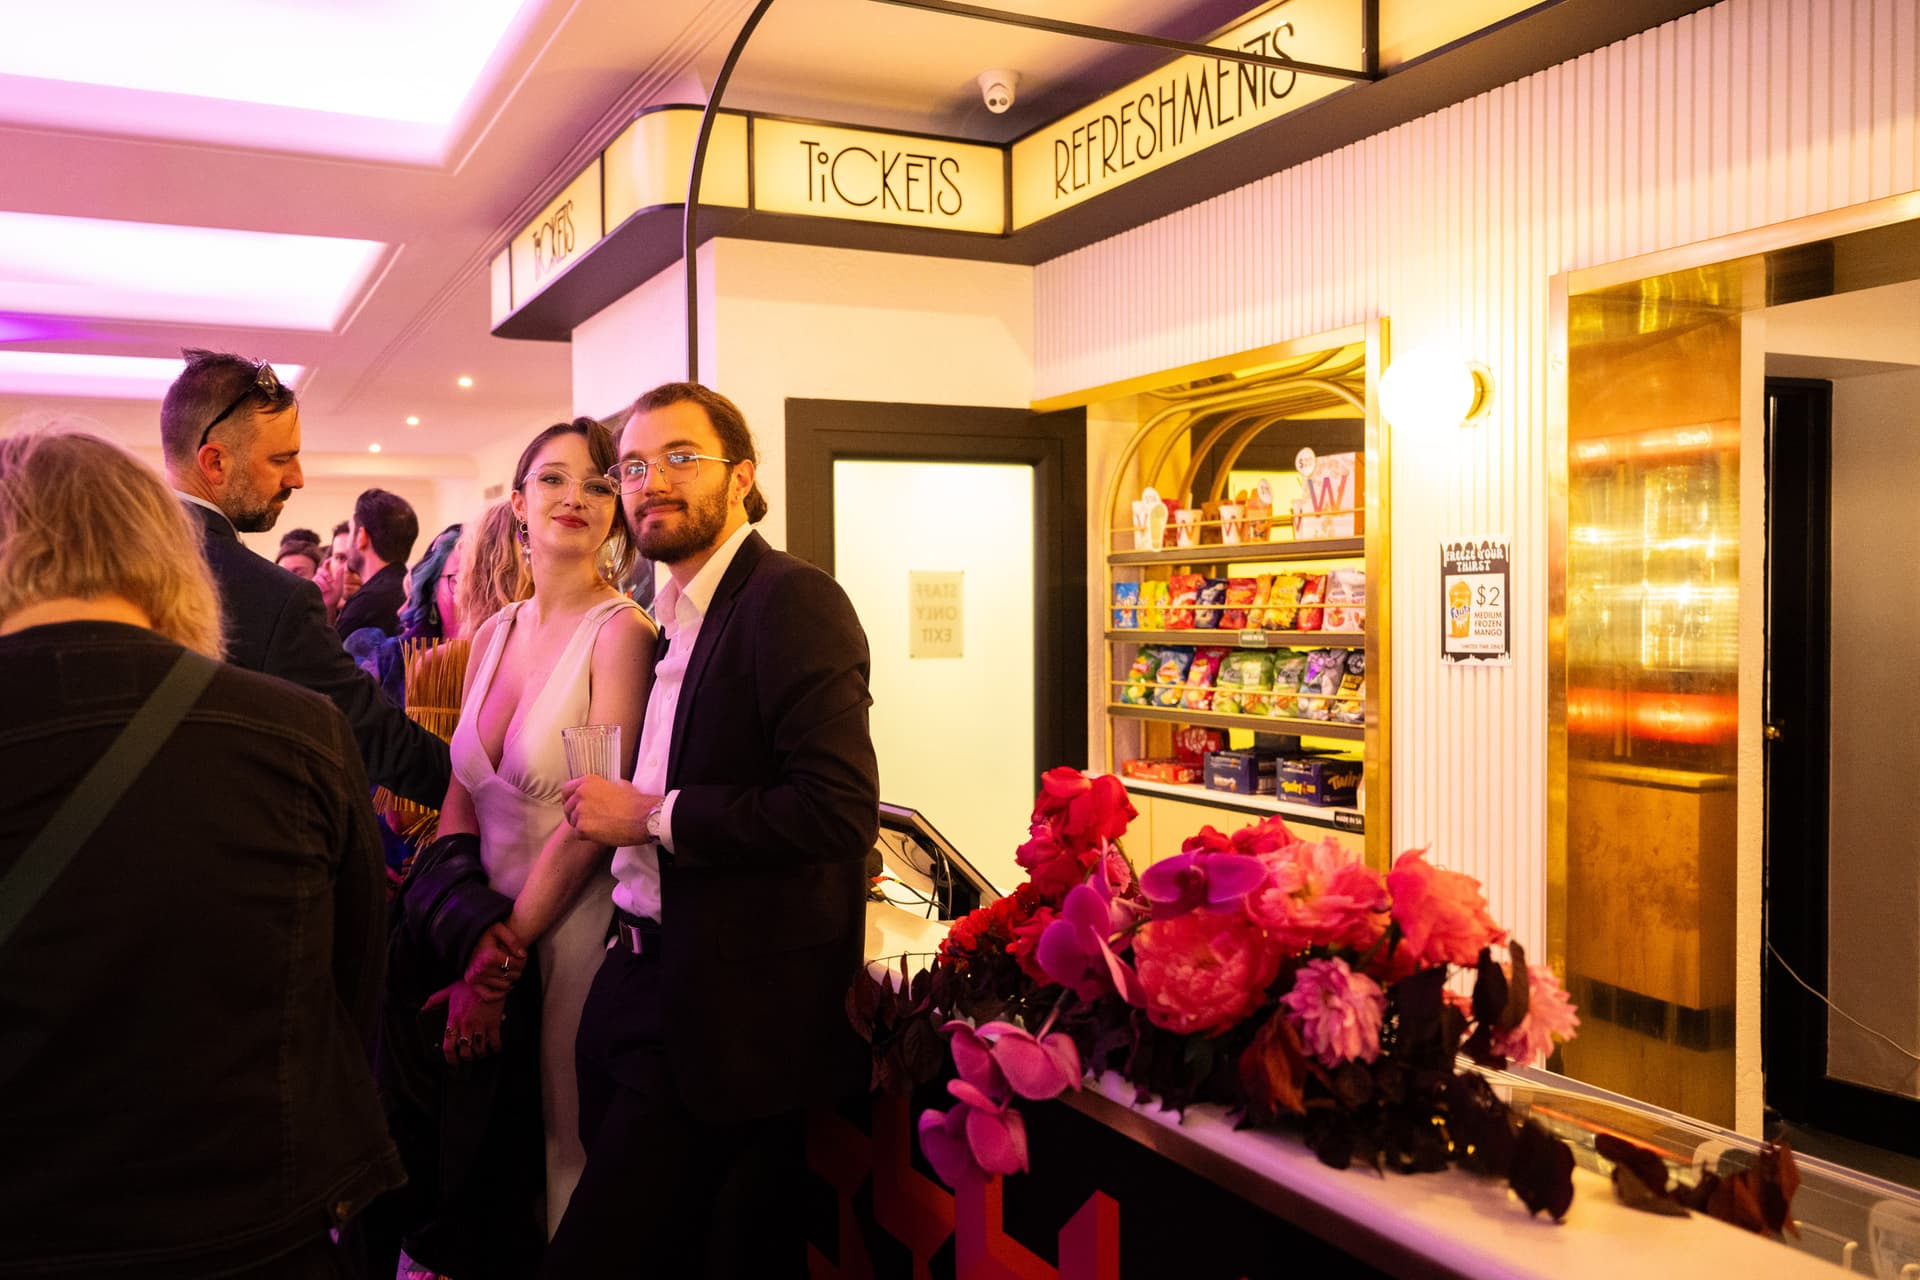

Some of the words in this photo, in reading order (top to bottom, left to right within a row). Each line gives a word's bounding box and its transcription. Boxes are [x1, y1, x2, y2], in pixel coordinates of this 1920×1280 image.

[1054, 21, 1297, 200] REFRESHMENTS
[1446, 549, 1476, 561] FREEZE
[1477, 548, 1504, 560] YOUR
[1456, 560, 1491, 572] THIRST
[1476, 584, 1500, 607] $2
[1474, 611, 1502, 619] MEDIUM
